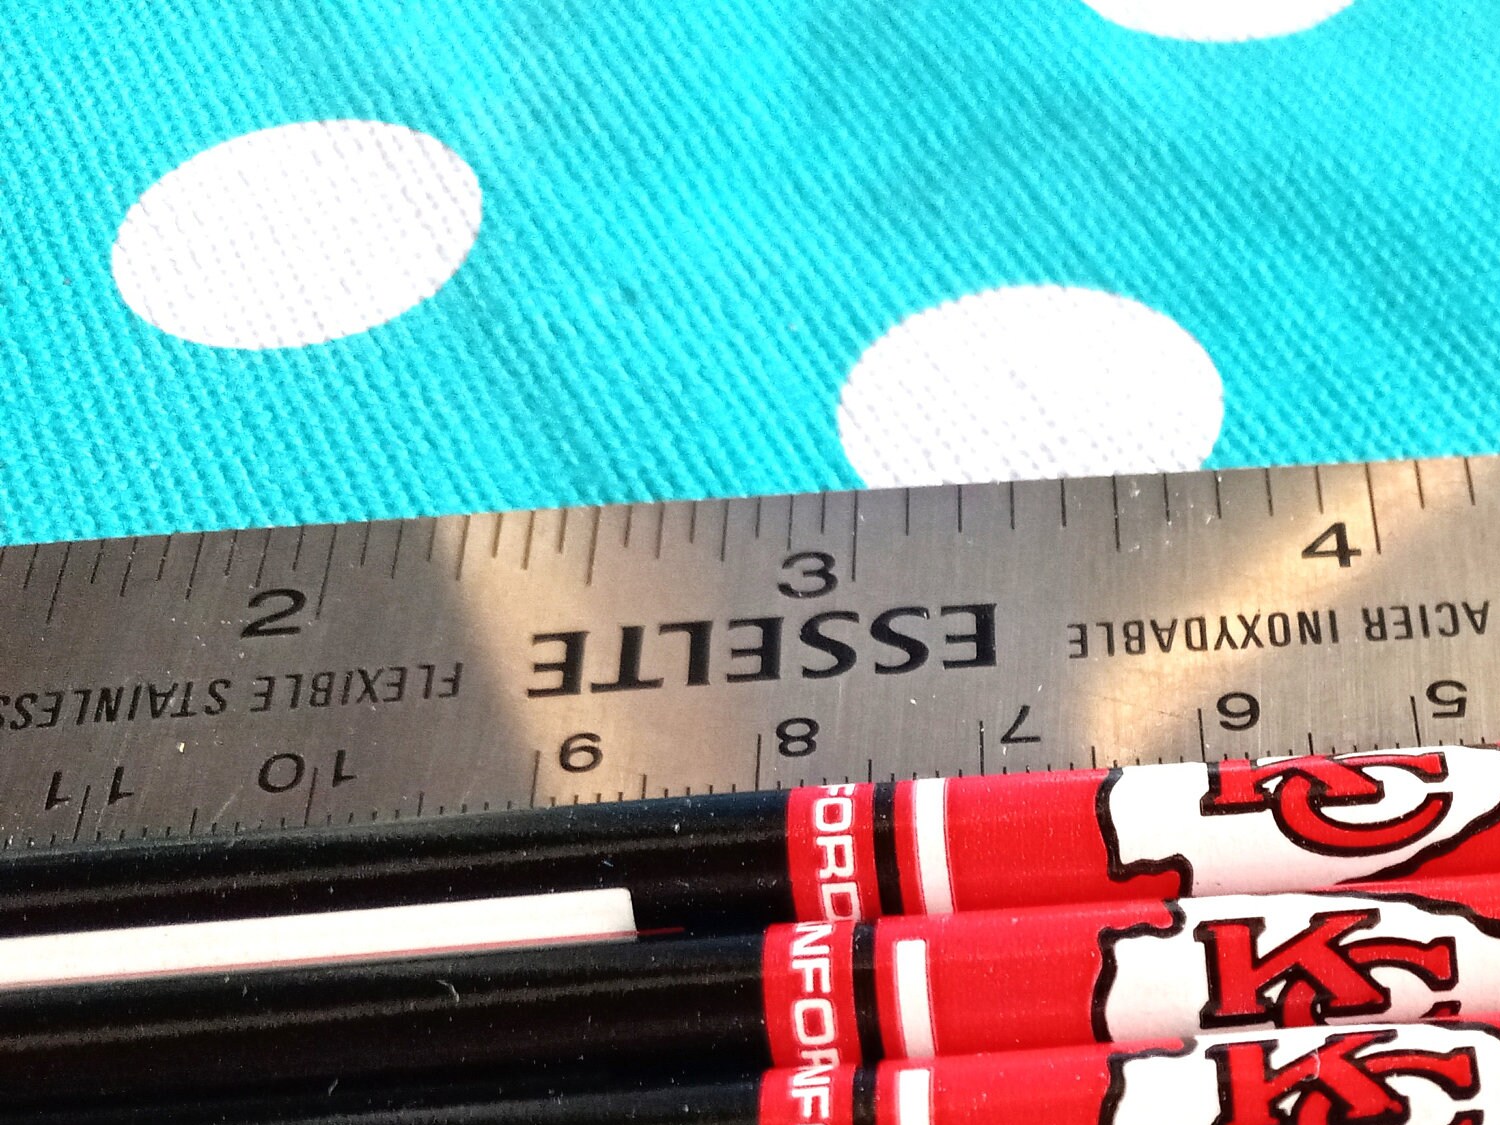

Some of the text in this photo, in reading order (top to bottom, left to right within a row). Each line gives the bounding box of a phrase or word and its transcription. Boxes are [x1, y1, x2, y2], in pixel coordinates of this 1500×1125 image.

[240, 588, 307, 639] 2
[777, 551, 838, 599] 3
[1301, 522, 1361, 568] 4
[1067, 608, 1339, 660] INOXYDABLE
[1364, 600, 1490, 643] ACIER
[526, 602, 998, 699] ESSELTE
[249, 662, 464, 713] FLEXIBLE
[1425, 679, 1468, 719] 5
[1000, 704, 1041, 746] 7
[1216, 691, 1261, 732] 6
[559, 732, 603, 773] 9
[775, 717, 820, 758] 8
[258, 749, 358, 794] 10
